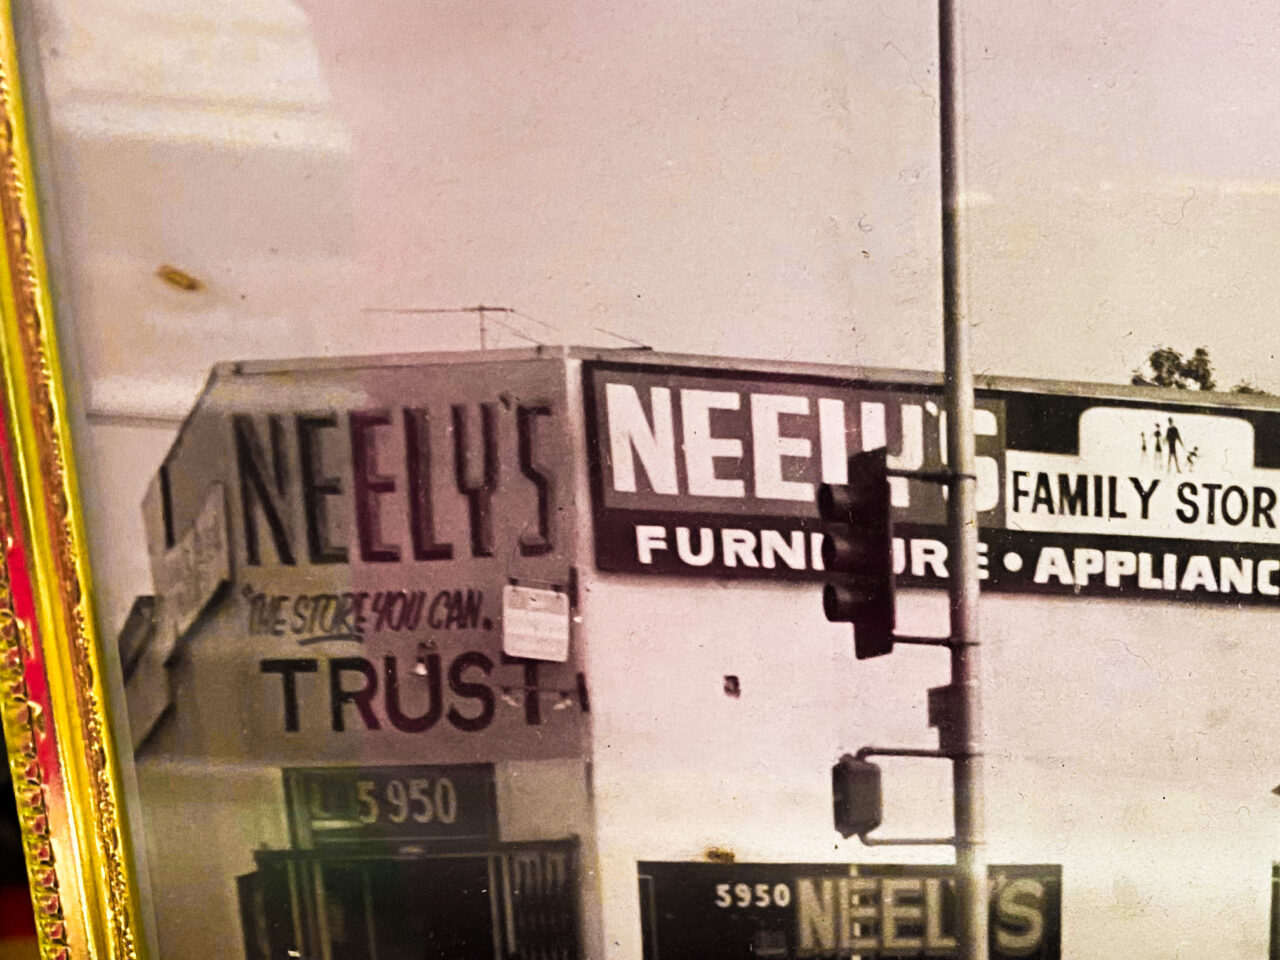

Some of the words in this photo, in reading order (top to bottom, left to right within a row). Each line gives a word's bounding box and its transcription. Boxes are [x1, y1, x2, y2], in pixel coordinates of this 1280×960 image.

[229, 390, 554, 566] NEELY'S
[1011, 470, 1160, 521] FAMILY
[355, 777, 457, 825] 5950
[716, 883, 790, 908] 5950
